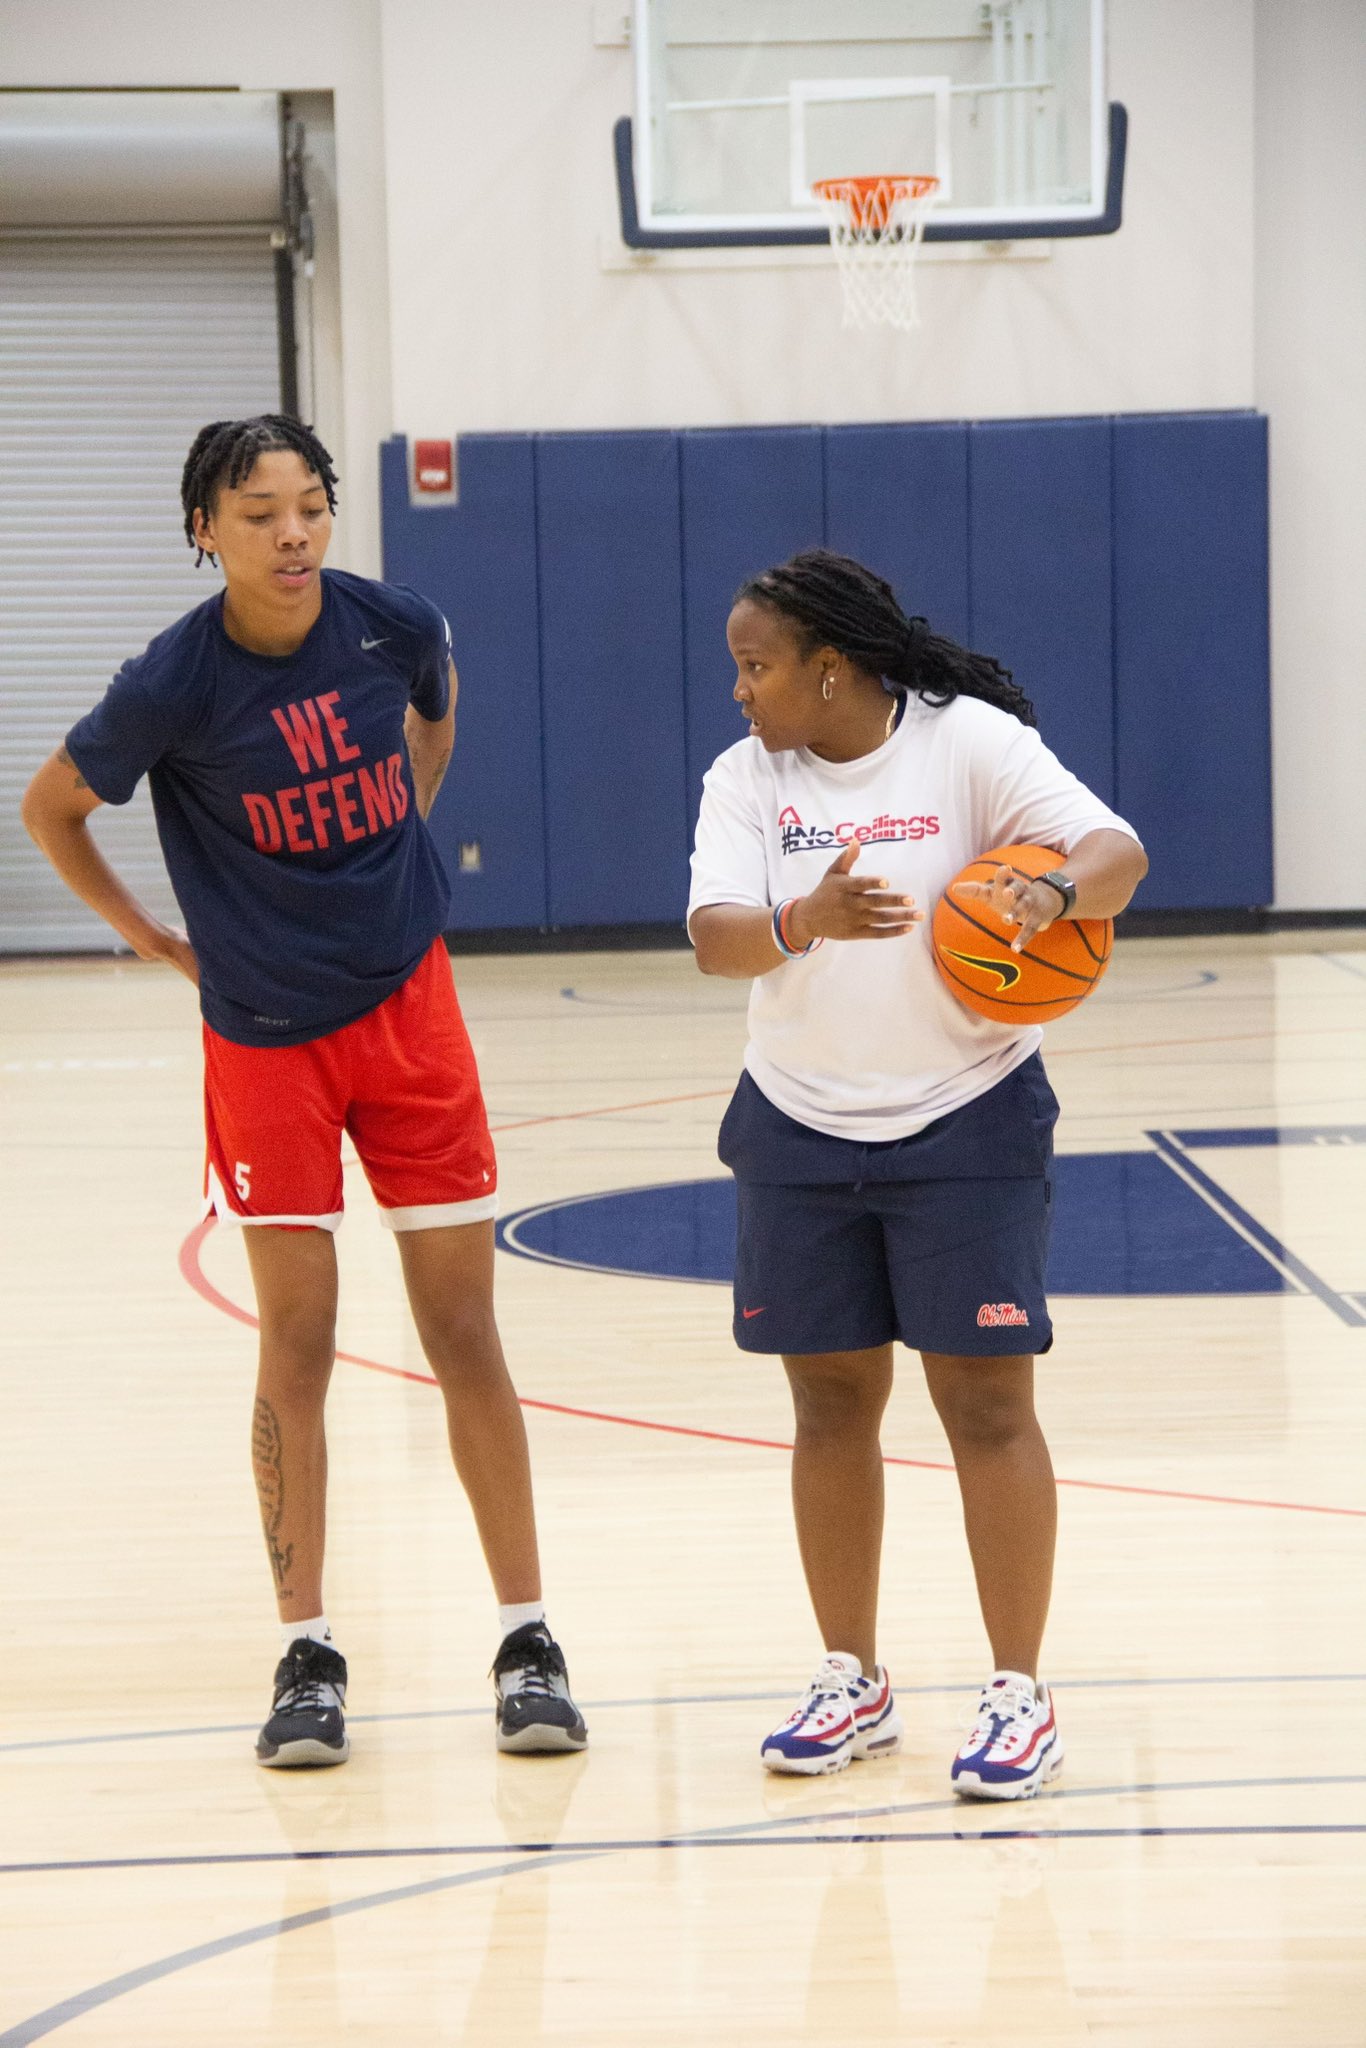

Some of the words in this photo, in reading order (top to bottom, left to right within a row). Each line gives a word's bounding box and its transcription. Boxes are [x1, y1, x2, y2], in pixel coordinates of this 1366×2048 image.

[271, 690, 361, 774] WE
[242, 753, 408, 854] DEFEND
[235, 1161, 251, 1201] 5
[977, 1304, 999, 1327] Ole
[997, 1303, 1028, 1326] Miss
